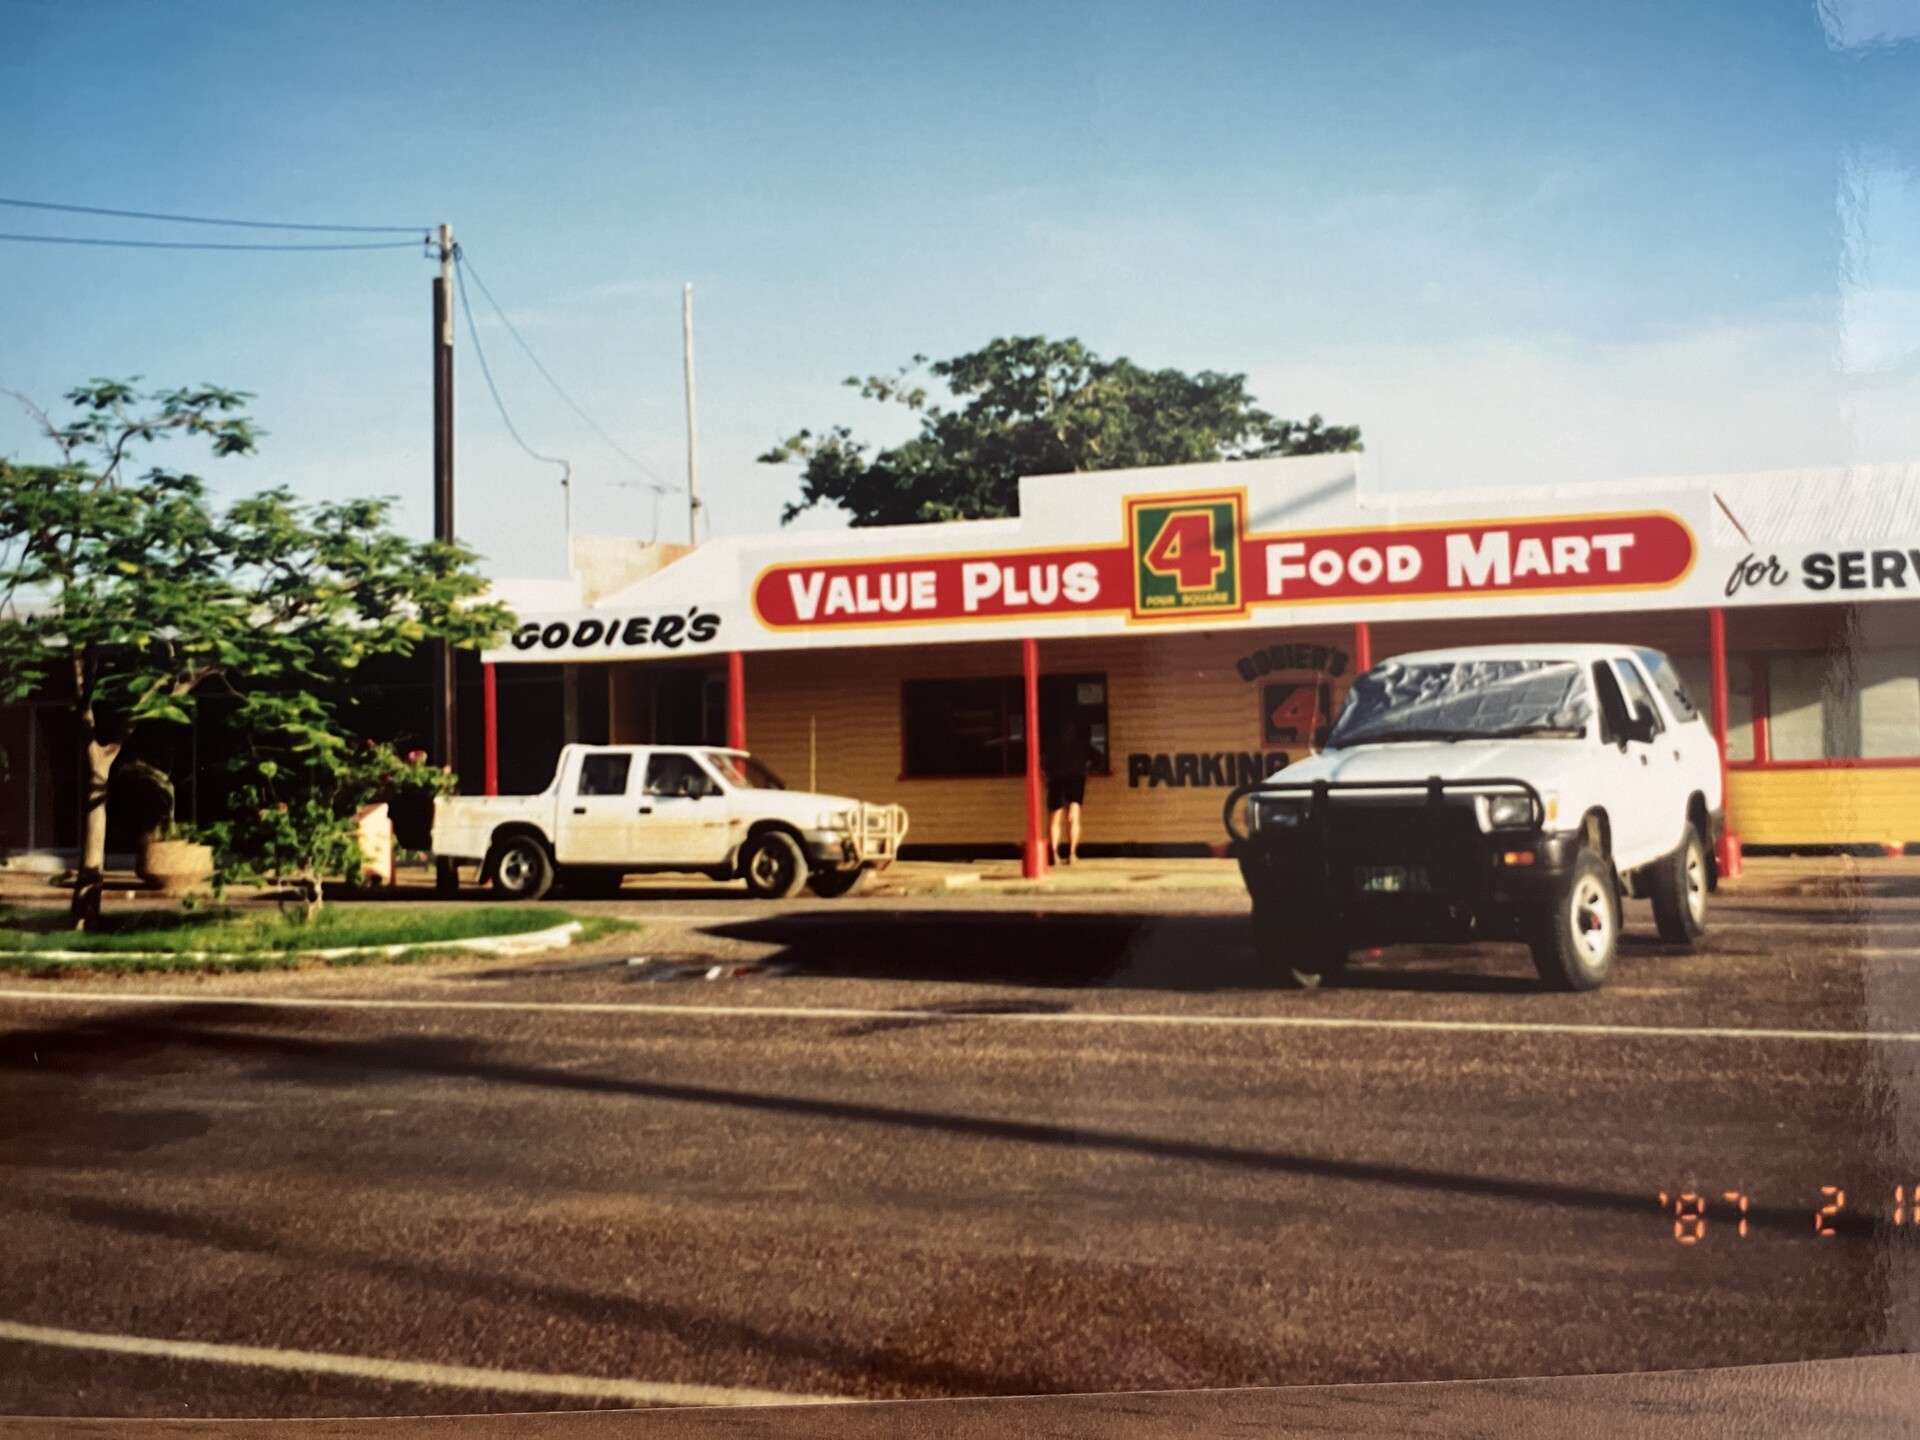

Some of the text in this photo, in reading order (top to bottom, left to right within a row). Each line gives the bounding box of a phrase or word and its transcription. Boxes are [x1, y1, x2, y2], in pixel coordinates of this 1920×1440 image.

[788, 531, 1634, 621] VALUE PLUS FOOD MART
[1143, 509, 1225, 592] 4
[1725, 553, 1788, 597] for
[511, 606, 721, 650] GODIER'S
[1272, 687, 1326, 740] 4
